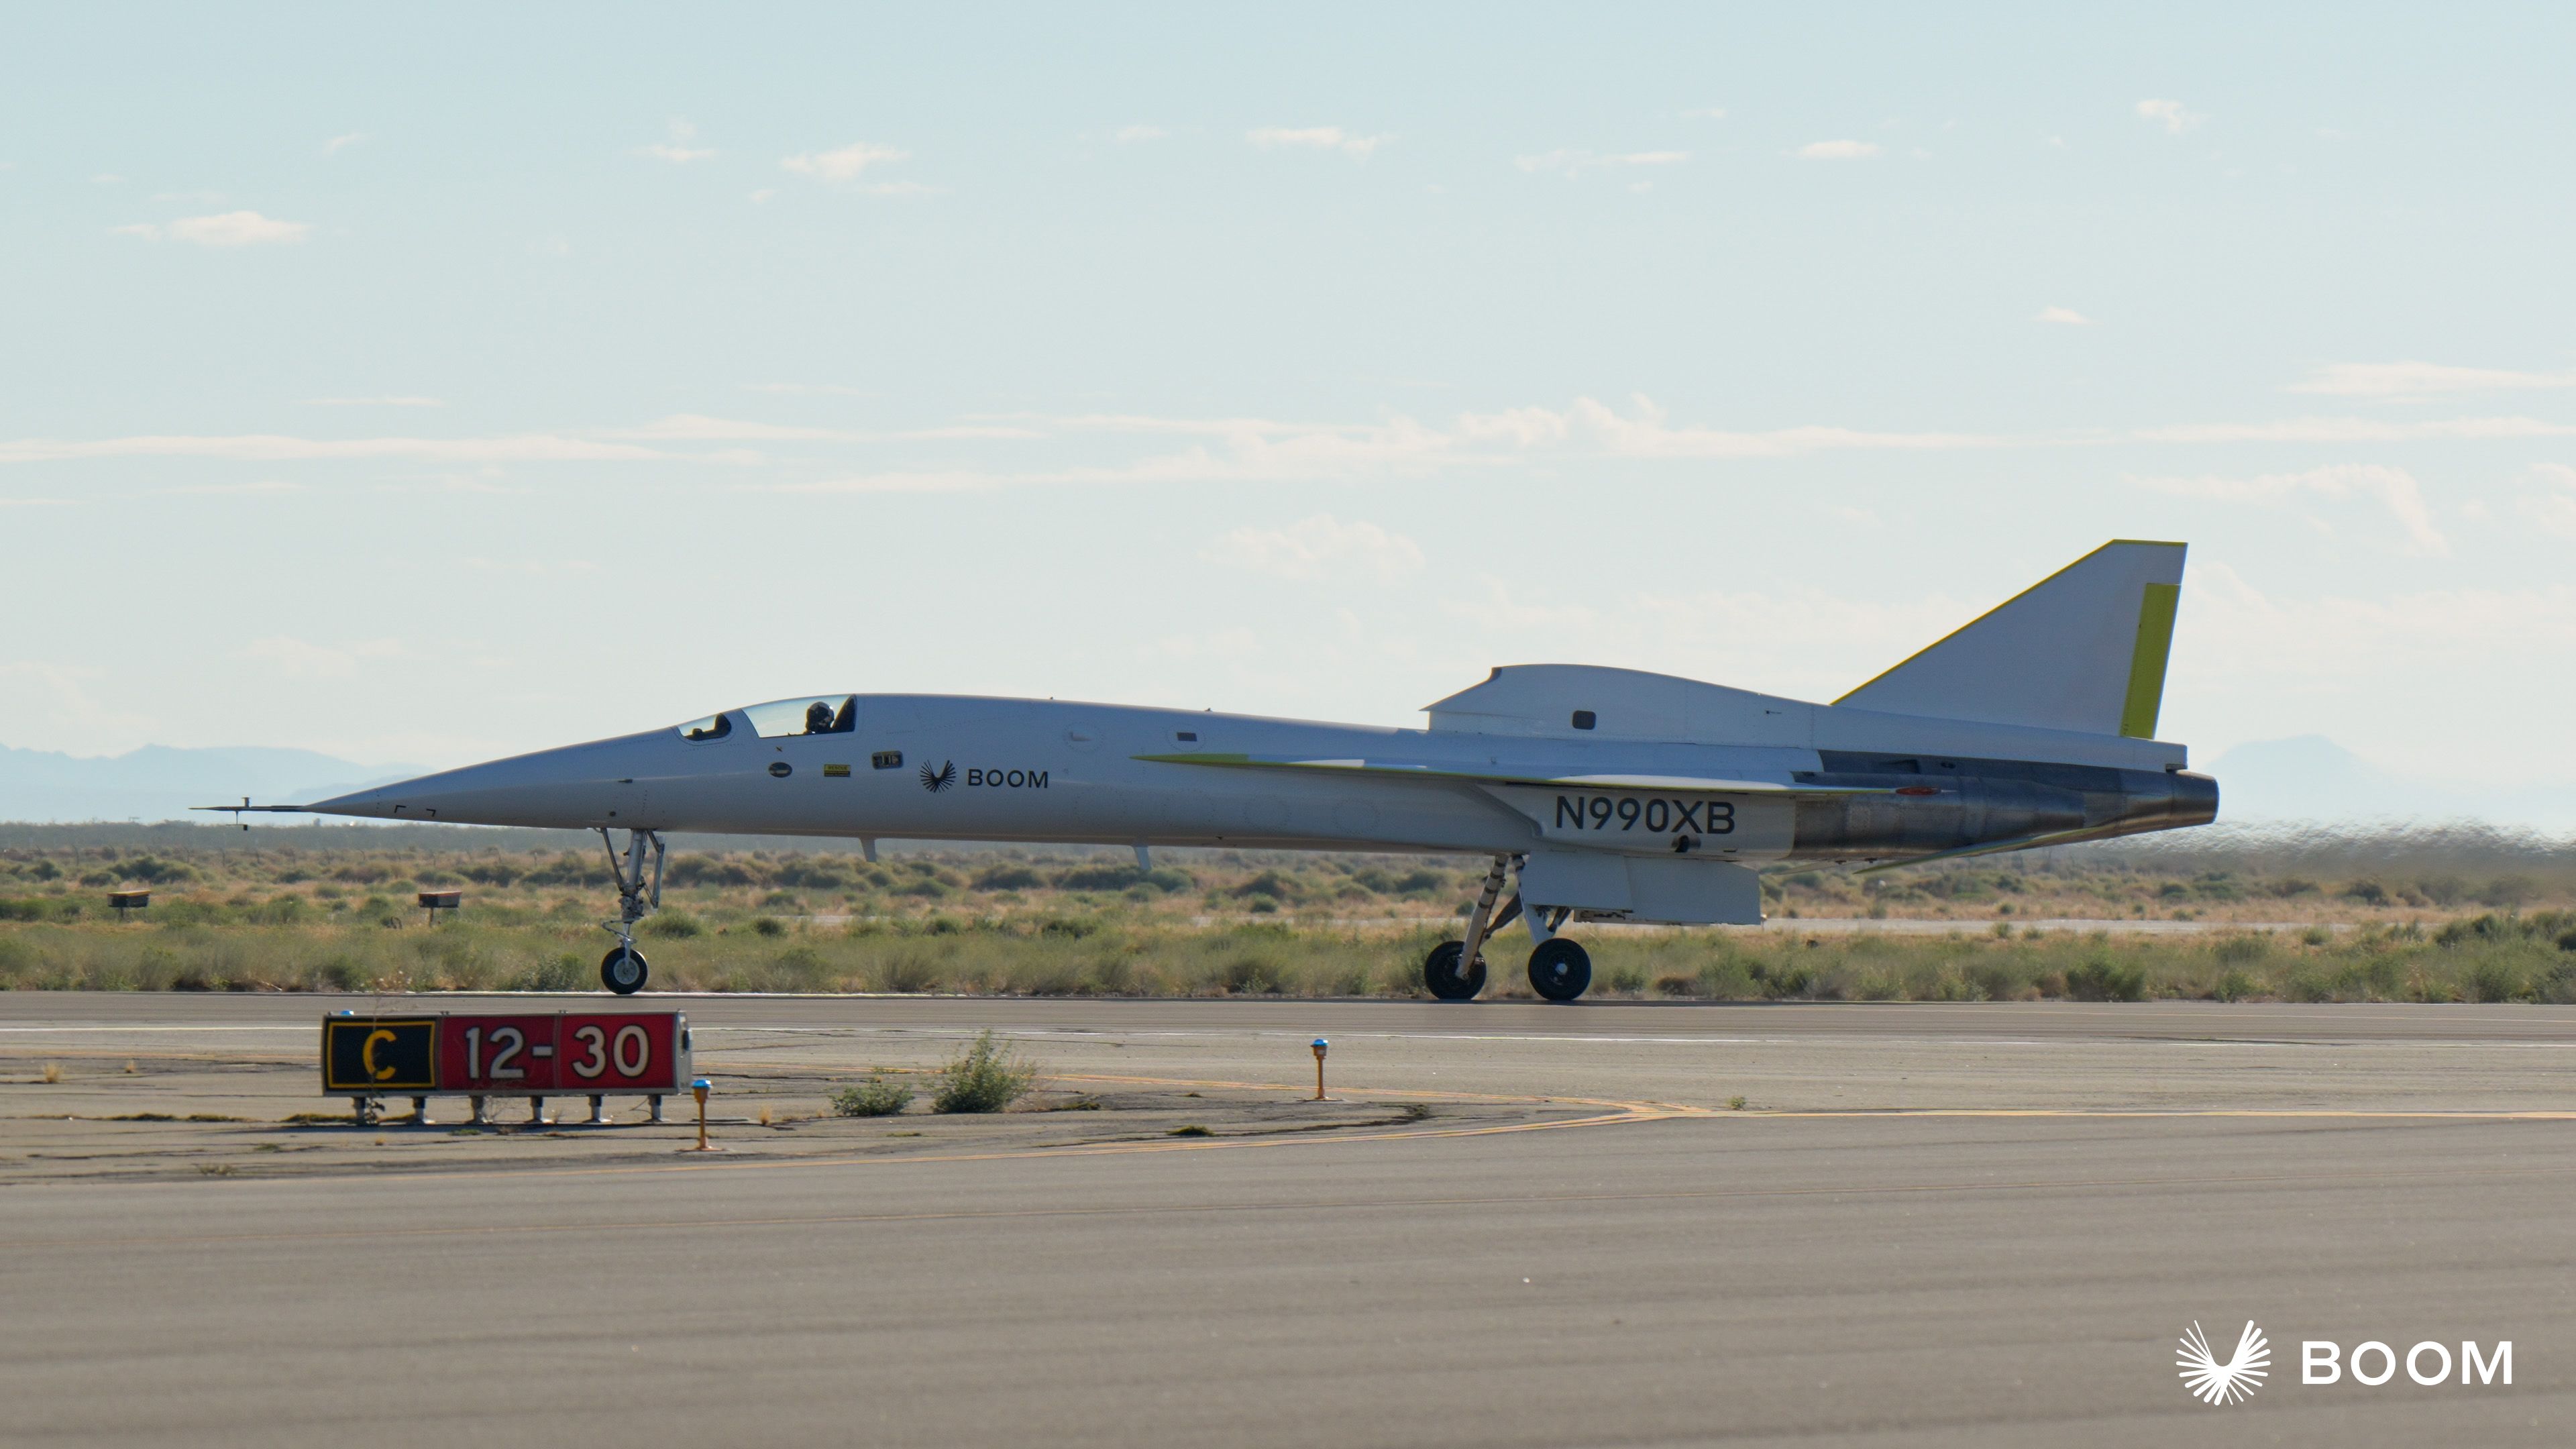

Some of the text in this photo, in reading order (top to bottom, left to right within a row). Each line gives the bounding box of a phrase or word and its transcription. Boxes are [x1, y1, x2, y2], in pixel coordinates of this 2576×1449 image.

[968, 769, 1048, 788] BOOM
[1556, 796, 1735, 834] N990XB
[363, 1024, 649, 1080] C 12-30
